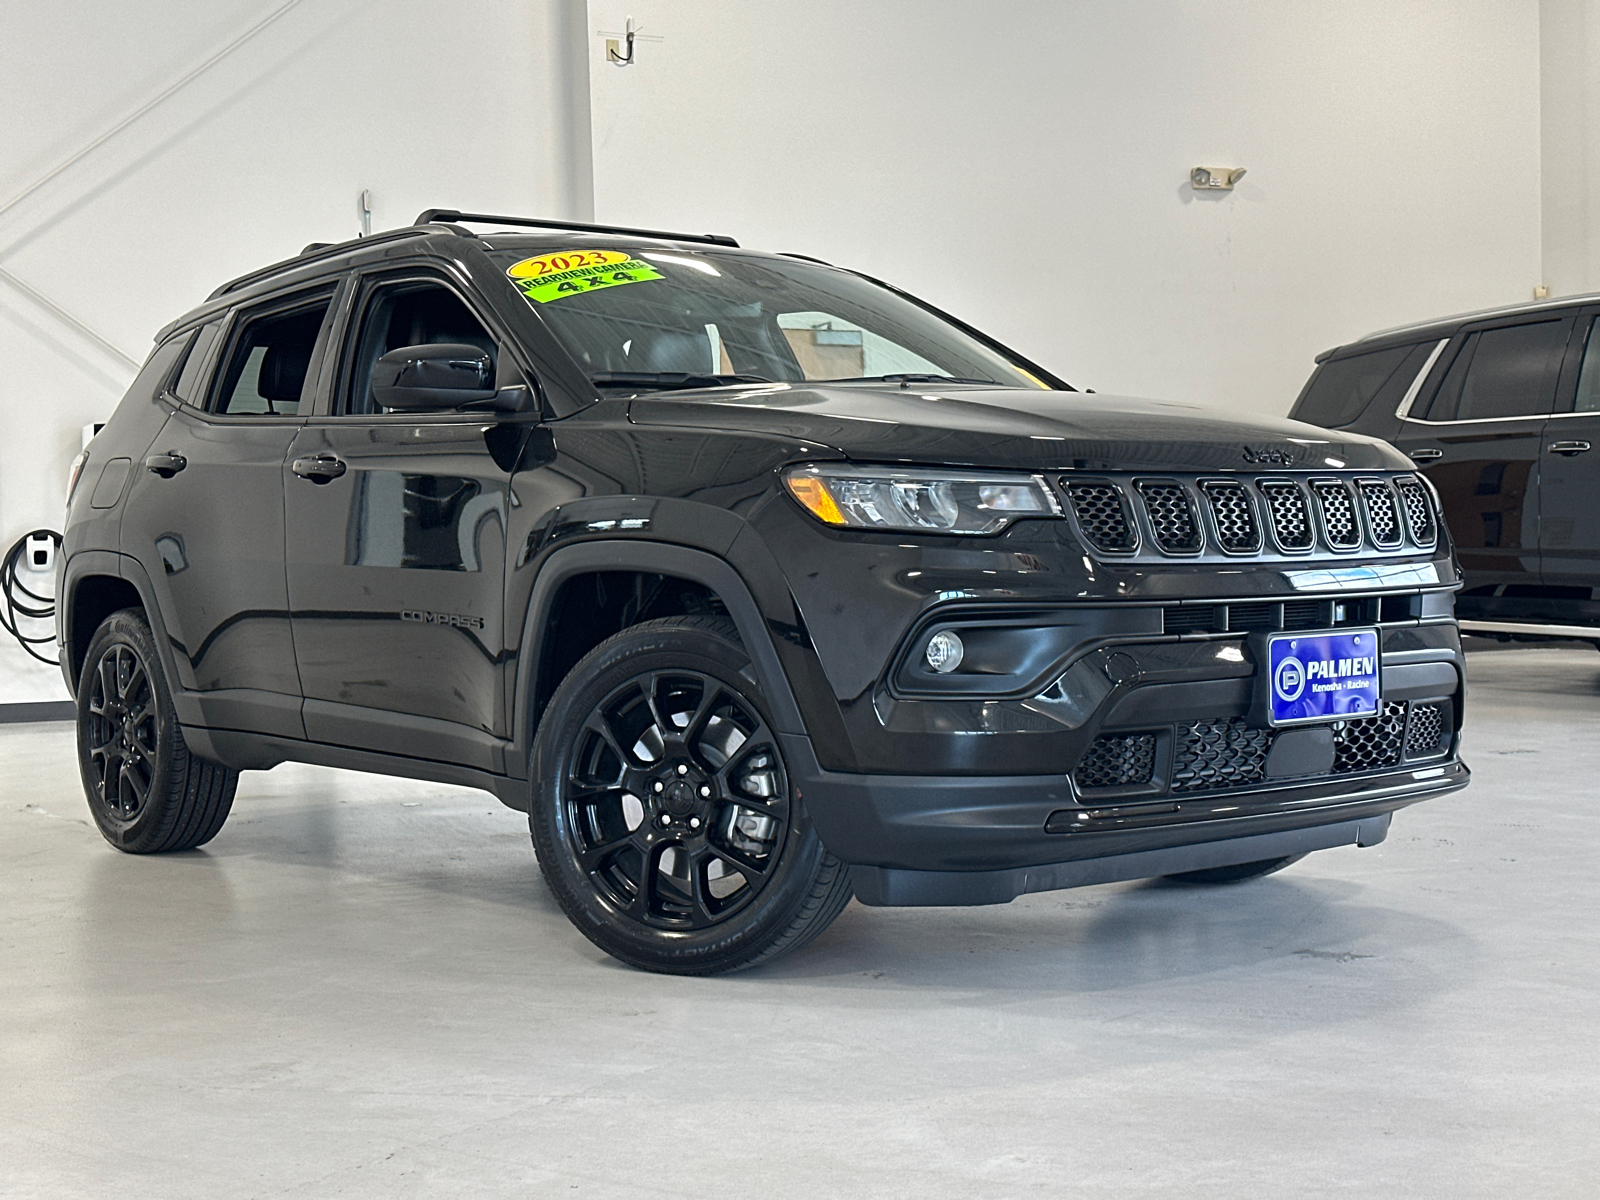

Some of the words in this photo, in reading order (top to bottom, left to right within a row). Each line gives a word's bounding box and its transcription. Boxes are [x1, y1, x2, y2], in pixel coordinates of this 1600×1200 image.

[531, 251, 608, 275] 2023
[524, 267, 592, 289] REARVIEW
[597, 261, 648, 274] CAMERA
[557, 281, 581, 293] 4
[612, 271, 635, 282] 4
[1242, 446, 1294, 467] Jeep
[401, 610, 483, 629] COMPASS
[1307, 656, 1374, 680] PALMEN
[1312, 682, 1342, 693] Kenosha
[1347, 680, 1369, 690] Racine
